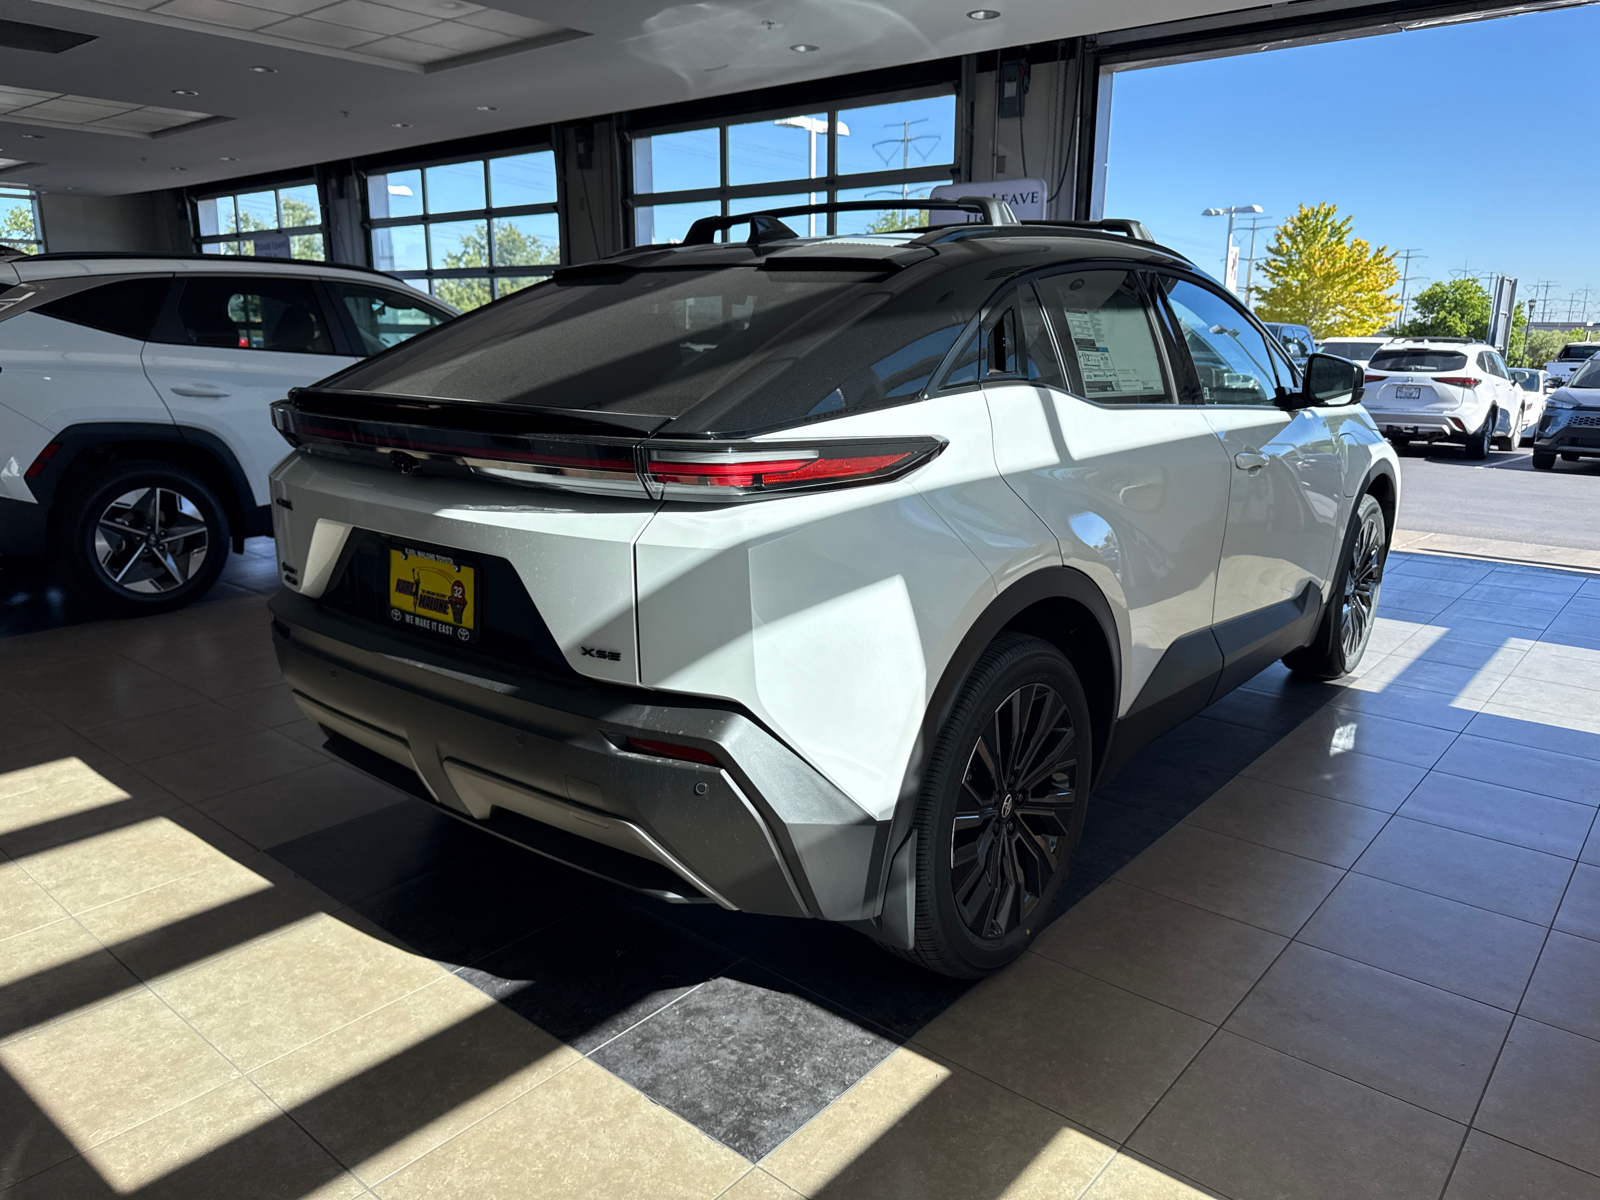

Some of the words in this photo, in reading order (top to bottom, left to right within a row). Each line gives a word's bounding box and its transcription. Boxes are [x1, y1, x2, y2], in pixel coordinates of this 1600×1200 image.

[395, 578, 416, 596] KARL
[454, 586, 463, 598] 32
[418, 594, 450, 615] MALONE
[405, 614, 414, 625] WE
[415, 617, 431, 629] MAKE
[431, 620, 438, 632] IT
[438, 624, 453, 635] EASY
[580, 646, 622, 662] XSE
